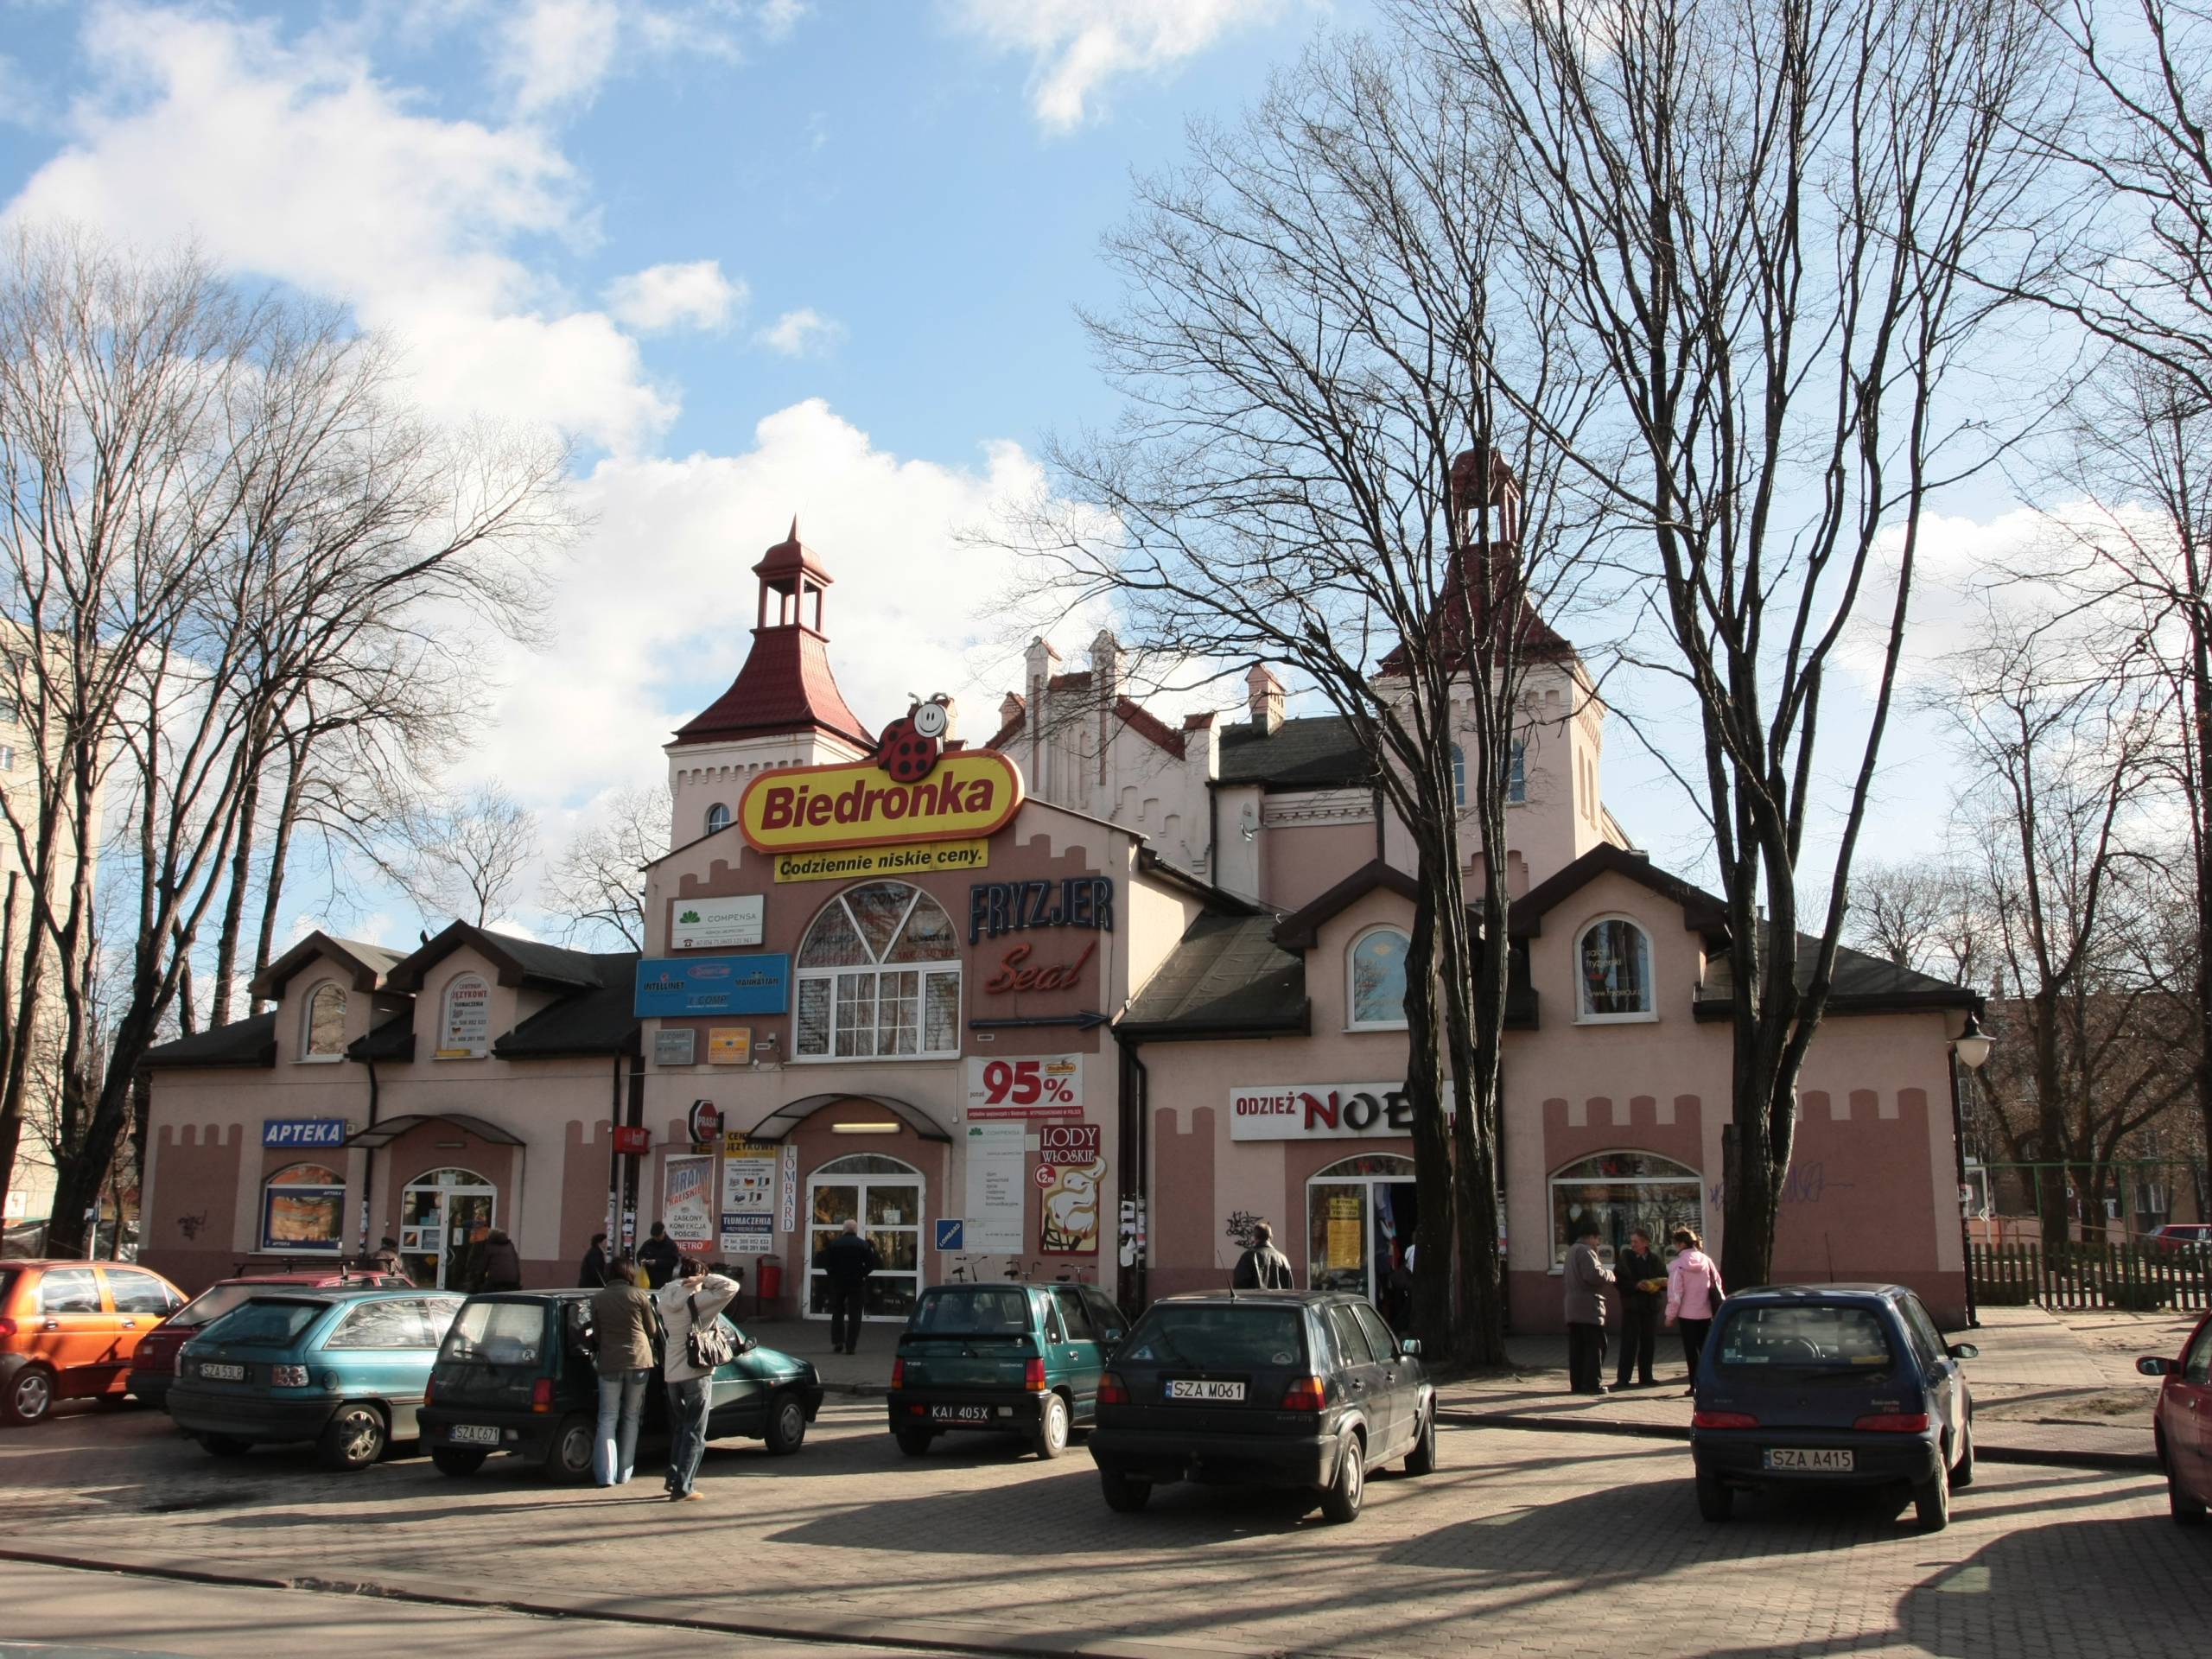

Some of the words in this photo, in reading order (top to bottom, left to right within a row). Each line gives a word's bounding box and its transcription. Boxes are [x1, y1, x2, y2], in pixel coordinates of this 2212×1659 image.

[760, 771, 994, 830] Biedronka
[780, 854, 872, 876] Codziennie
[878, 849, 932, 868] niskie
[937, 849, 982, 866] ceny.
[707, 912, 757, 923] COMPENSA
[969, 876, 1114, 945] FRYZJER
[985, 940, 1097, 995] Seal
[644, 982, 685, 991] INTELLINET
[735, 977, 779, 987] MANHATTAN
[1236, 1091, 1296, 1116] ODZIEŻ
[1297, 1090, 1415, 1130] NOE
[266, 1124, 340, 1141] APTEKA
[1043, 1128, 1097, 1147] LODY
[1041, 1149, 1095, 1163] WŁOSKIE
[1042, 1174, 1055, 1184] 2m
[783, 1147, 796, 1230] LOMBARD
[669, 1223, 706, 1231] KONFEKCJA
[723, 1215, 772, 1225] TŁUMACZENIA
[939, 1223, 961, 1248] LOMBARD
[203, 1364, 221, 1376] SZA
[1174, 1382, 1204, 1397] SZA
[1210, 1384, 1242, 1398] M061
[931, 1406, 952, 1418] KAI
[958, 1407, 988, 1420] 405X
[456, 1426, 475, 1439] SZA
[477, 1427, 499, 1440] C671
[1772, 1451, 1807, 1466] SZA
[1813, 1452, 1851, 1467] A415
